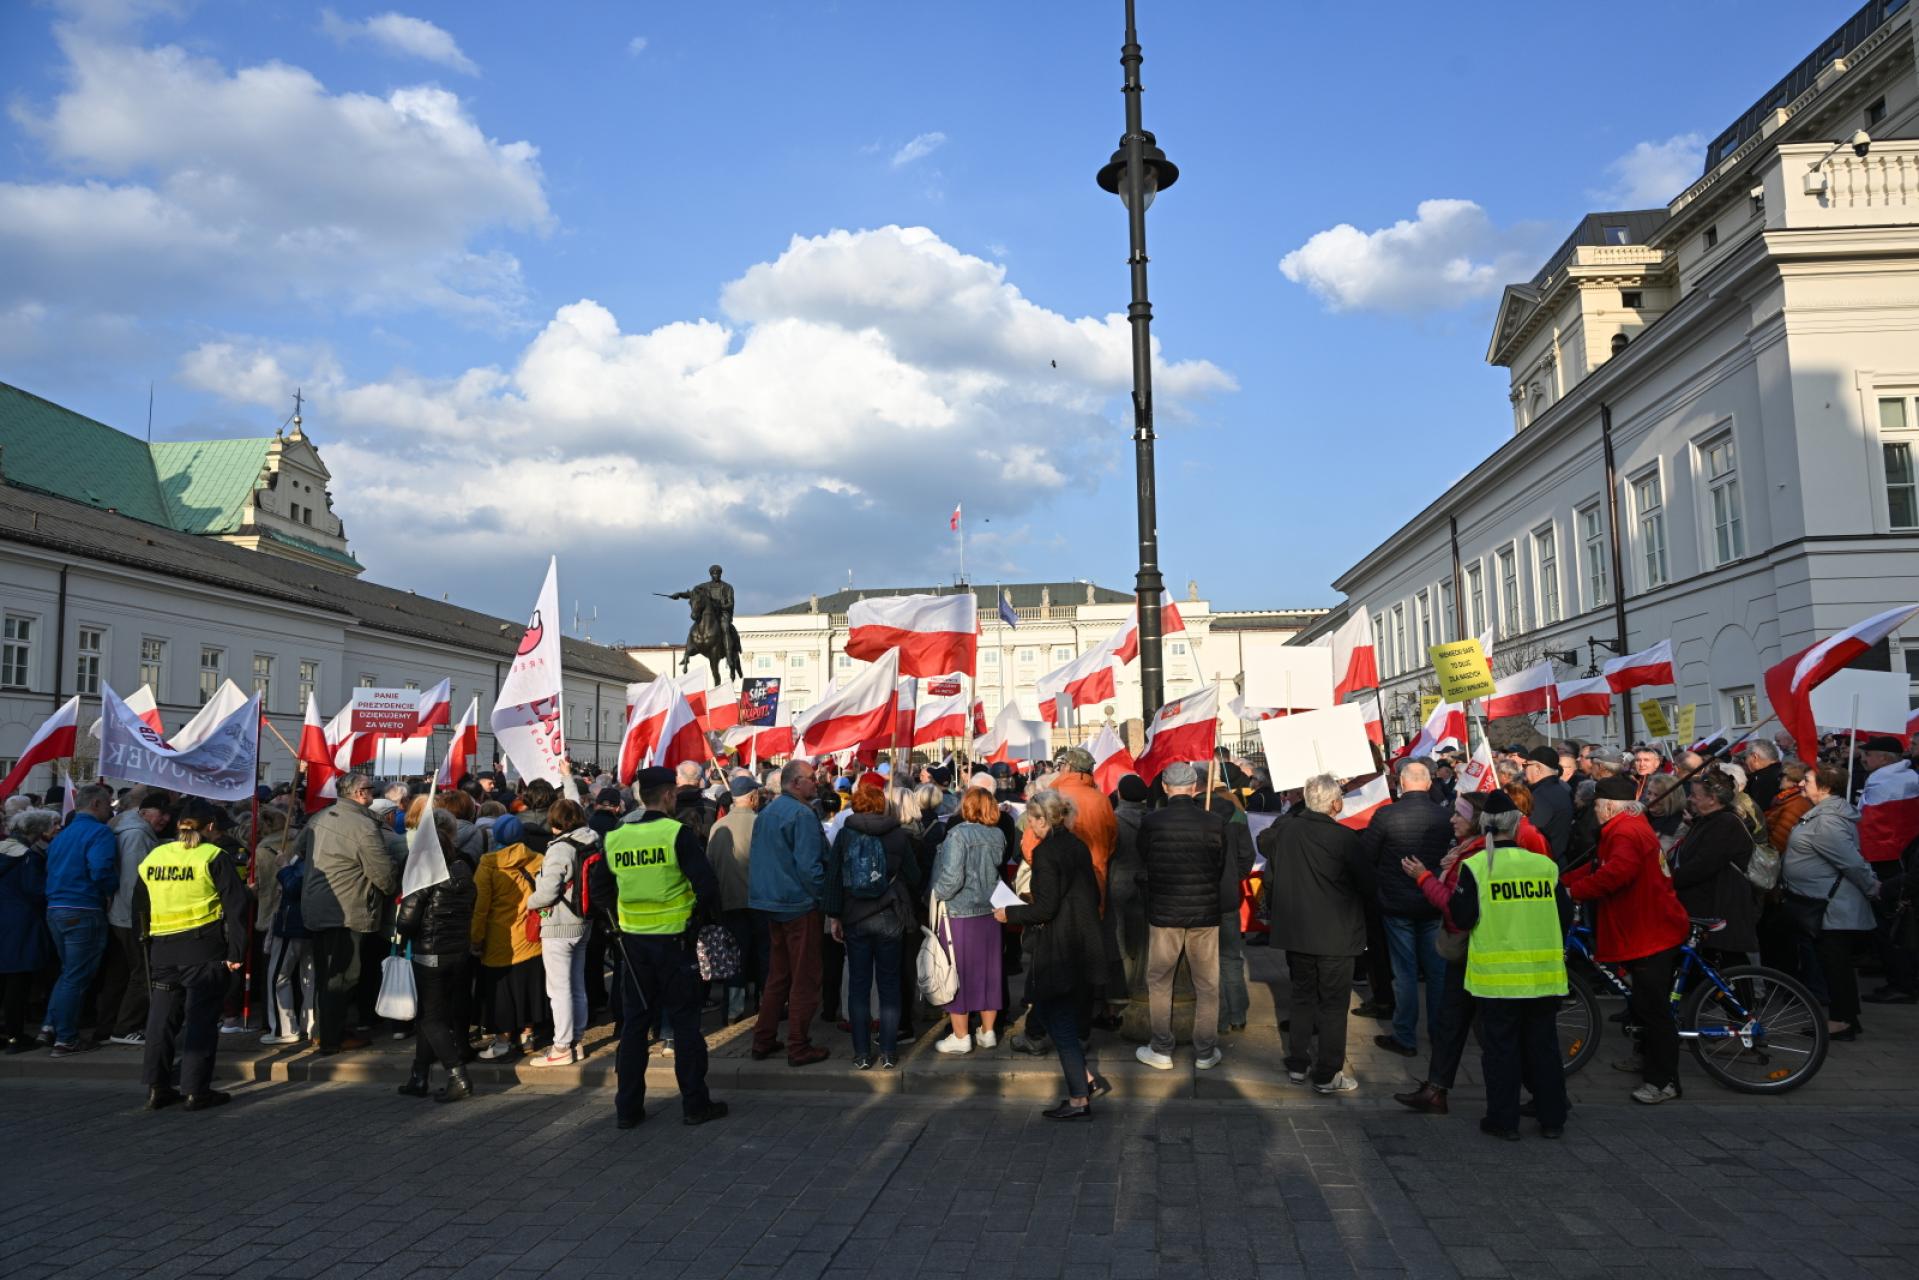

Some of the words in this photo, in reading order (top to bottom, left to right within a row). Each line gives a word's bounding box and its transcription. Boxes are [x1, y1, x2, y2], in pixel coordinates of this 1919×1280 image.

[749, 688, 768, 701] SAFE
[358, 701, 415, 710] PREZYDENCIE
[359, 711, 411, 720] DZIĘKUJEMY
[378, 721, 404, 729] WETO
[614, 847, 667, 868] POLICJA
[147, 866, 194, 881] POLICJA
[1490, 880, 1553, 901] POLICJA
